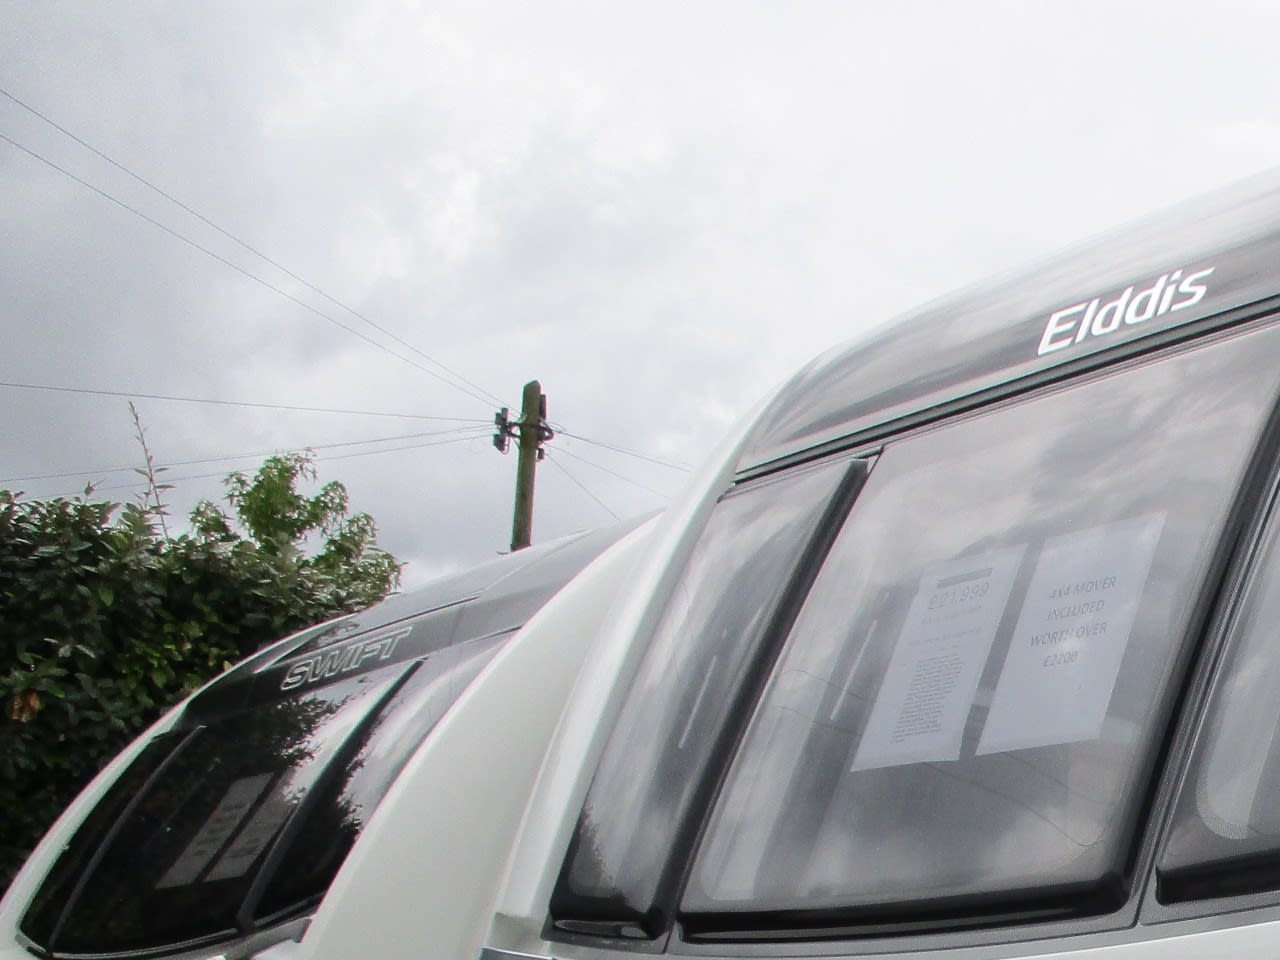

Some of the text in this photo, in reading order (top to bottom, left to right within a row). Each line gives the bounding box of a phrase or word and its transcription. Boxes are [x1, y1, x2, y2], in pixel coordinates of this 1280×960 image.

[1038, 266, 1215, 356] Elddis
[1073, 576, 1118, 597] MOVER
[1046, 600, 1106, 621] INCLUDED
[1030, 622, 1108, 649] WORTH OVER
[281, 625, 413, 691] SWIFT
